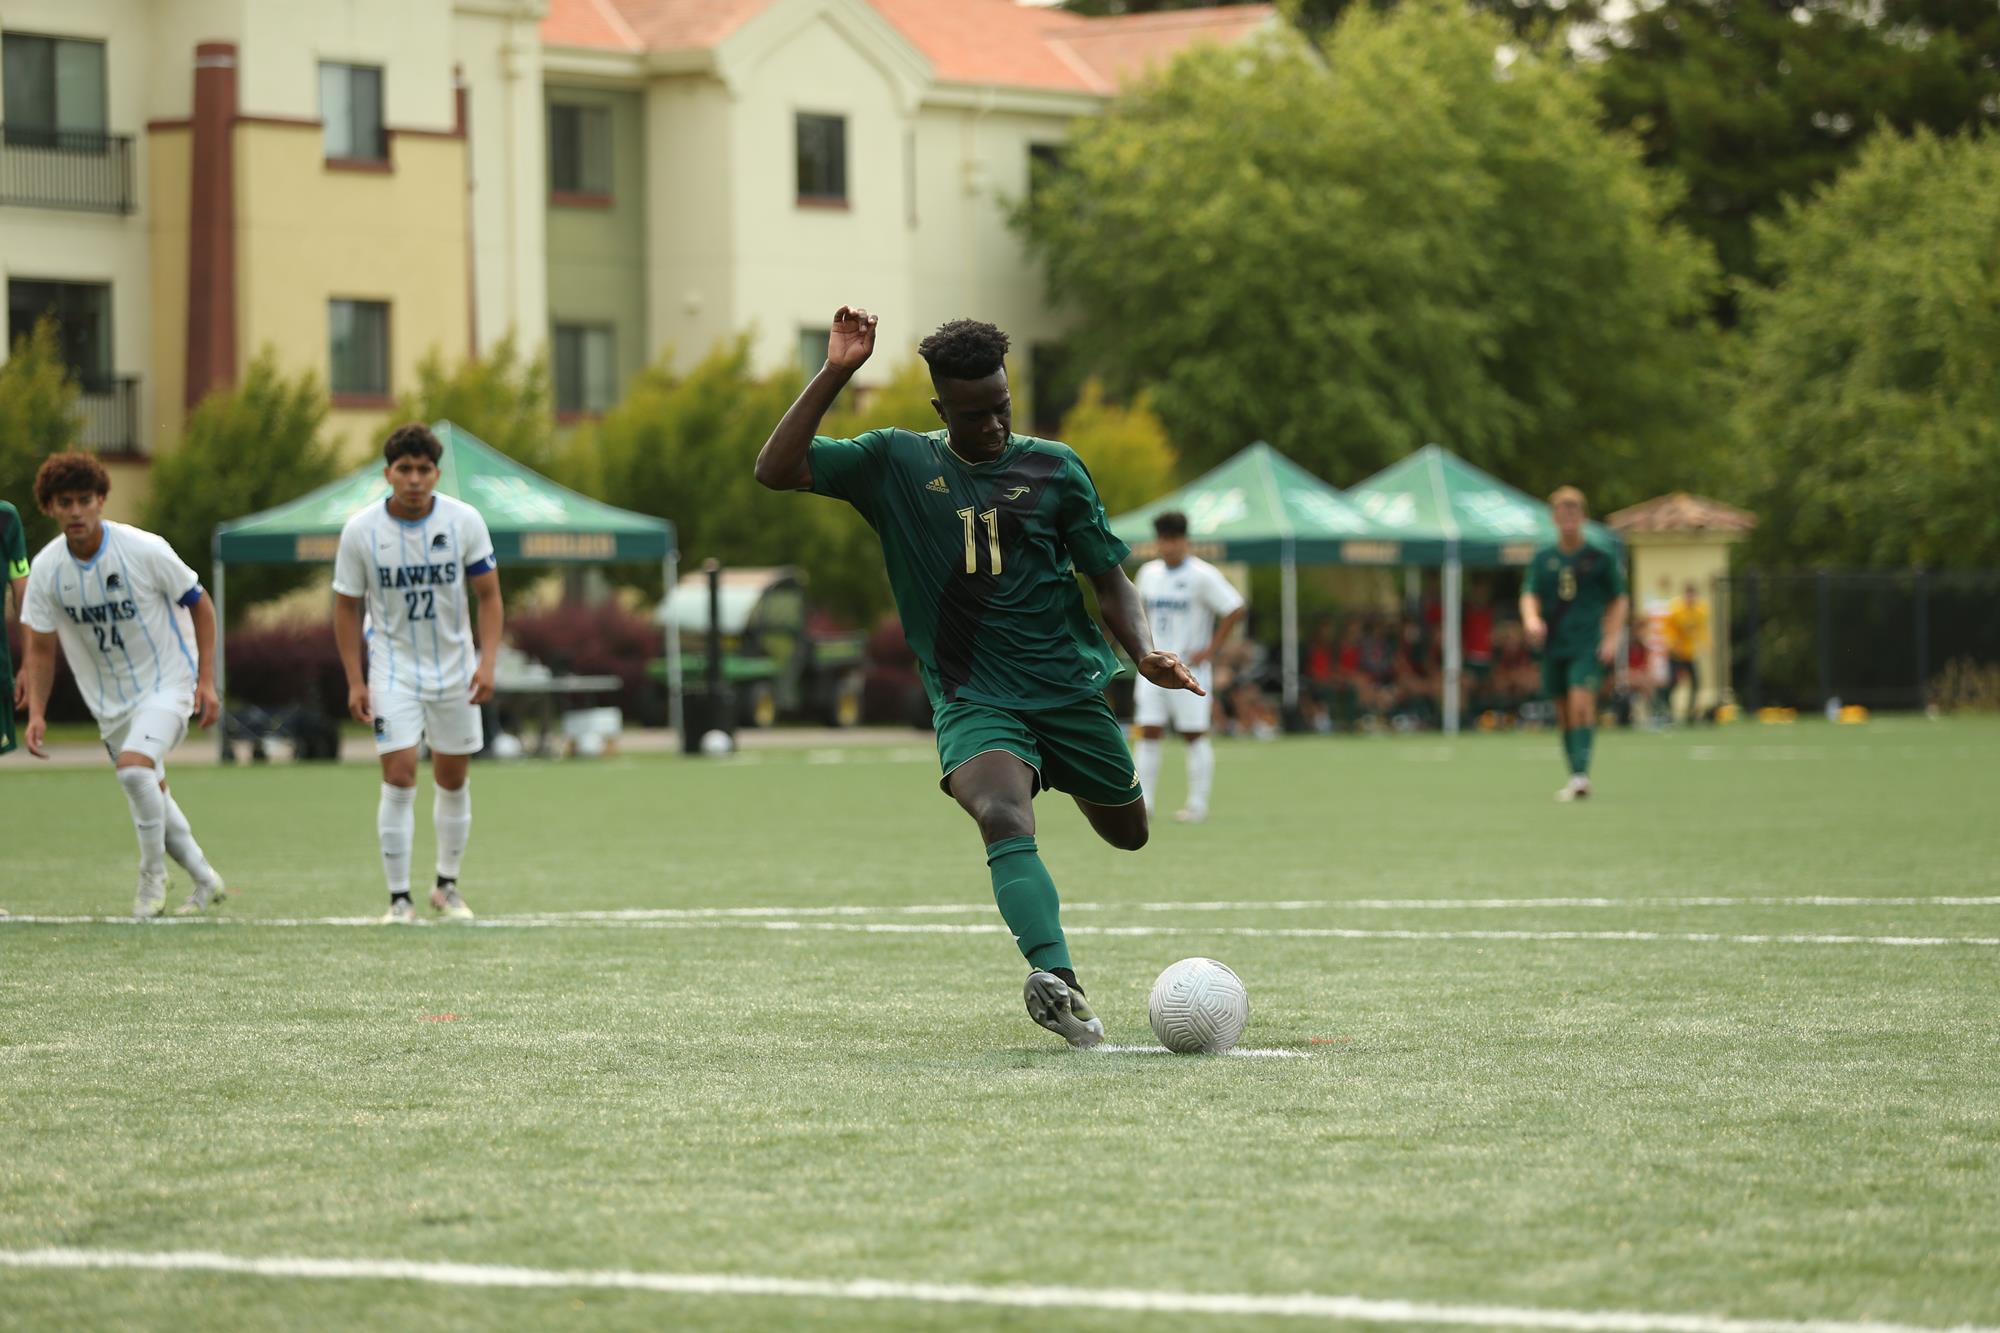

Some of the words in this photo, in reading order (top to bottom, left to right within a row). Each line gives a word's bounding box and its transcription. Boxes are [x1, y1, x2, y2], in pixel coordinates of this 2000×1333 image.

[925, 483, 950, 494] adidas
[956, 505, 1002, 575] 11
[378, 562, 457, 588] HAWKS
[64, 600, 136, 624] HAWKS
[405, 590, 436, 620] 22
[94, 624, 125, 653] 24
